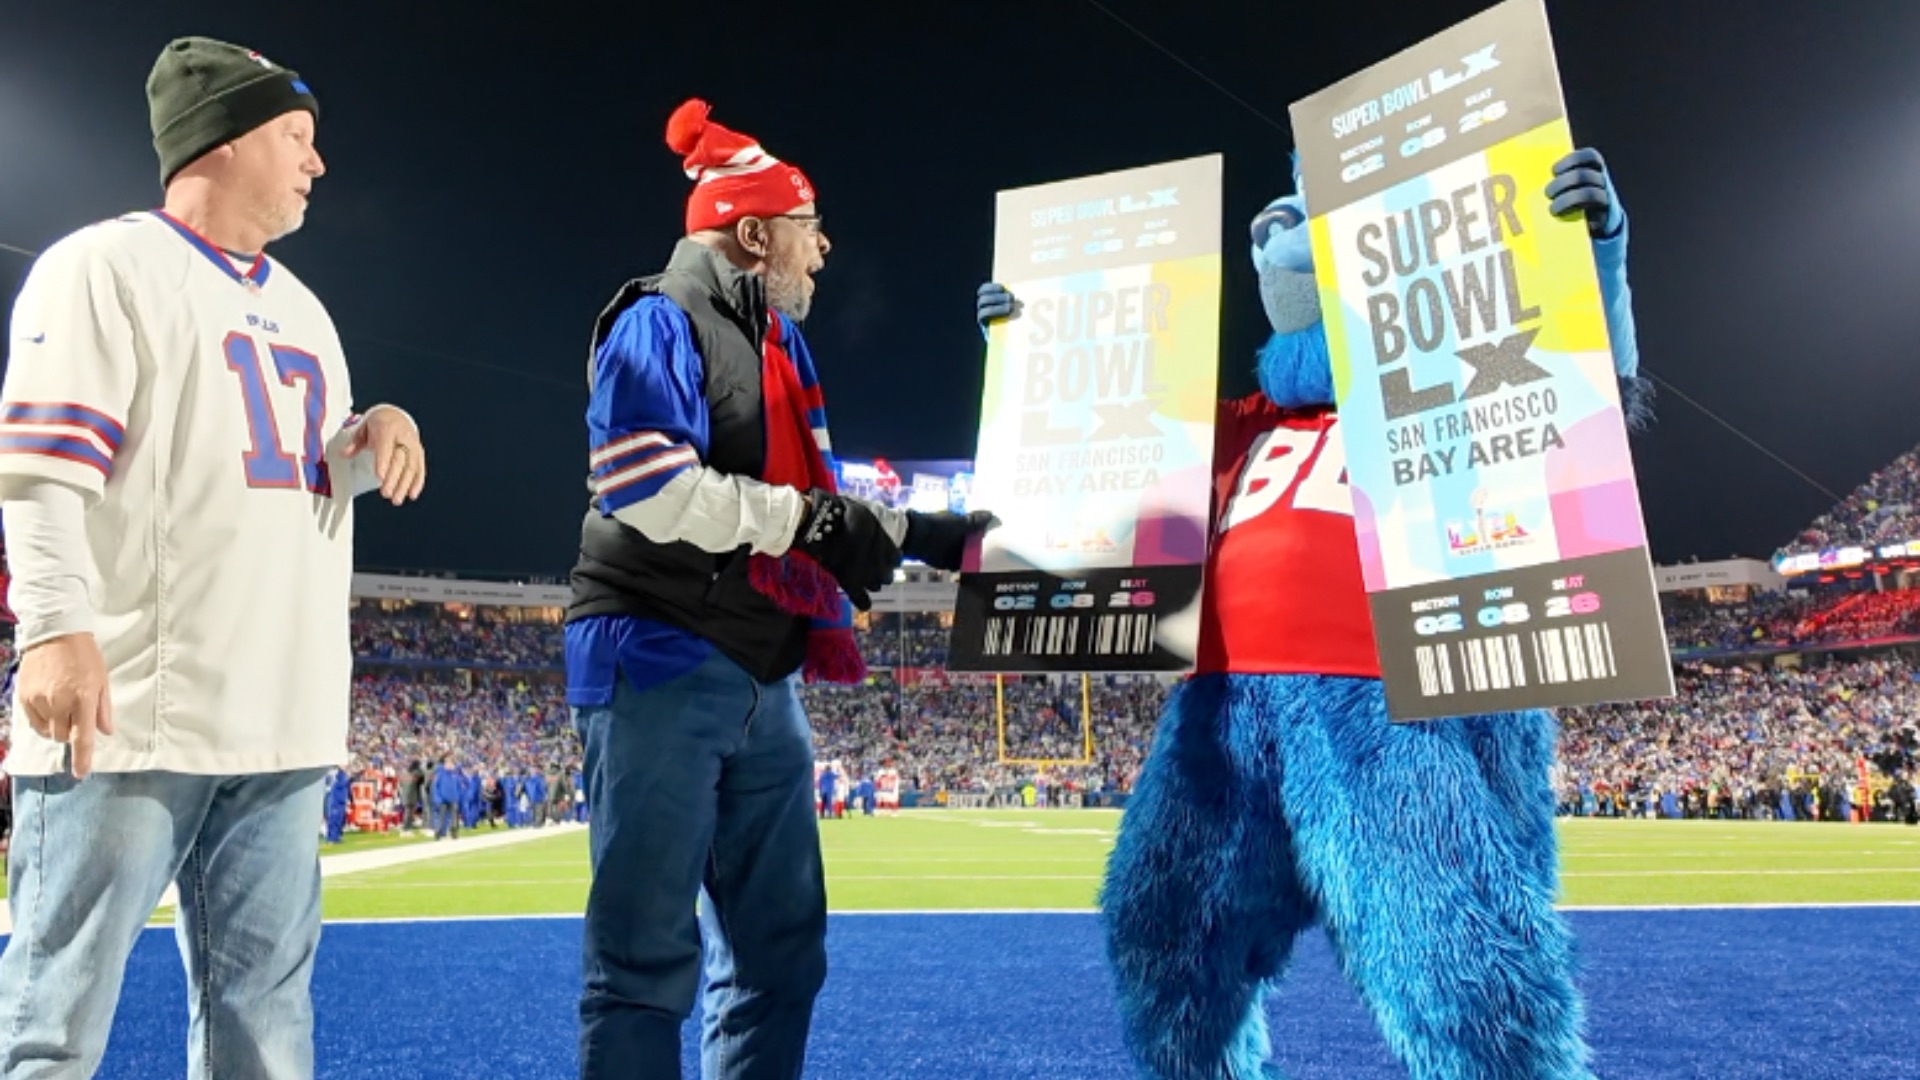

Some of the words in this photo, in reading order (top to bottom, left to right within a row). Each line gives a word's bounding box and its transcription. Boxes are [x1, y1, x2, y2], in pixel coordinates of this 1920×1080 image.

[1332, 100, 1380, 139] SUPER
[1382, 78, 1430, 117] BOWL
[1429, 42, 1501, 95] LX
[1341, 153, 1385, 183] 02
[1399, 126, 1447, 158] 08
[1119, 186, 1181, 213] LX
[1356, 173, 1524, 287] SUPER
[1028, 283, 1171, 347] SUPER
[1366, 249, 1541, 367] BOWL
[1024, 338, 1168, 406] BOWL
[1379, 325, 1554, 422] LX
[223, 330, 331, 498] 17
[1020, 398, 1166, 448] LX
[1386, 429, 1428, 455] SAN
[1435, 386, 1558, 443] FRANCISCO
[1014, 474, 1072, 496] BAY
[1079, 467, 1162, 493] AREA
[1016, 450, 1051, 473] SAN
[1057, 443, 1164, 471] FRANCISCO
[1392, 445, 1457, 487] BAY
[1466, 420, 1566, 471] AREA
[994, 594, 1037, 611] 02
[1050, 593, 1095, 609] 08
[1108, 591, 1156, 609] 26
[1414, 613, 1464, 636] 02
[1477, 602, 1530, 628] 08
[1545, 592, 1600, 618] 26
[1484, 586, 1514, 600] ROW
